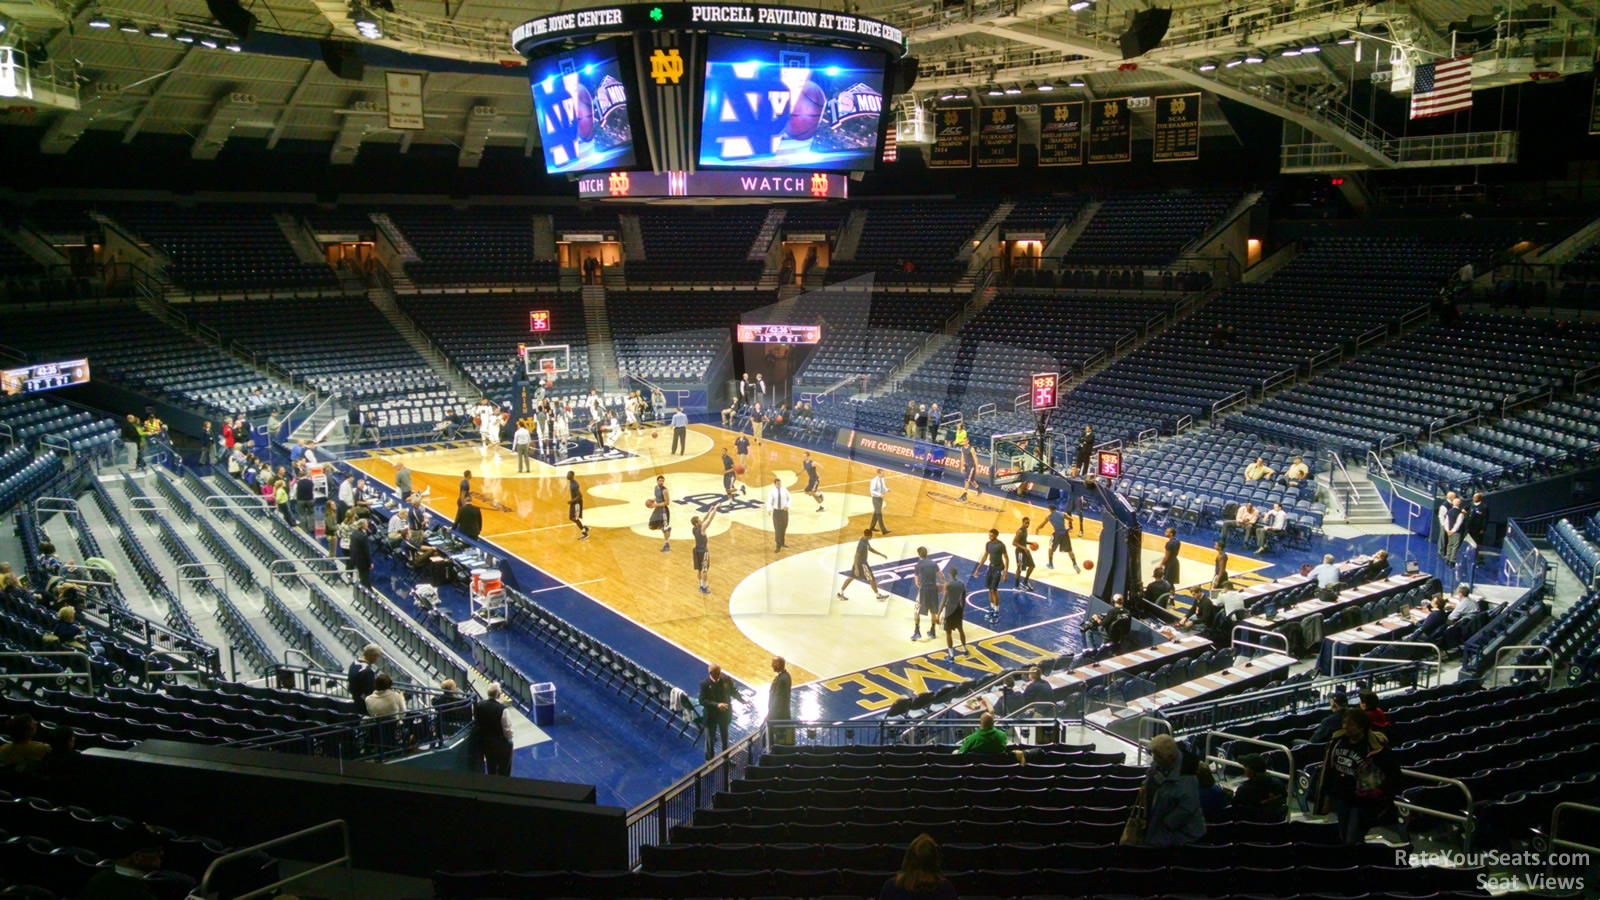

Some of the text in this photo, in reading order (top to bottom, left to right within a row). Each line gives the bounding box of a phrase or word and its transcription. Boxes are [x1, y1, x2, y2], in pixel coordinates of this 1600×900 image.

[533, 19, 547, 35] THE
[549, 14, 576, 32] JOYCE
[577, 9, 622, 28] CENTER
[692, 6, 754, 22] PURCELL
[758, 8, 817, 27] PAVILION
[819, 13, 834, 29] AT
[836, 15, 856, 32] THE
[857, 19, 882, 37] JOYCE
[939, 127, 963, 135] ACC
[741, 177, 805, 191] WATCH
[533, 319, 546, 329] 35
[1034, 376, 1055, 388] 43:35
[860, 437, 878, 449] FIVE
[877, 441, 925, 461] CONFEREN
[1103, 463, 1116, 475] 35
